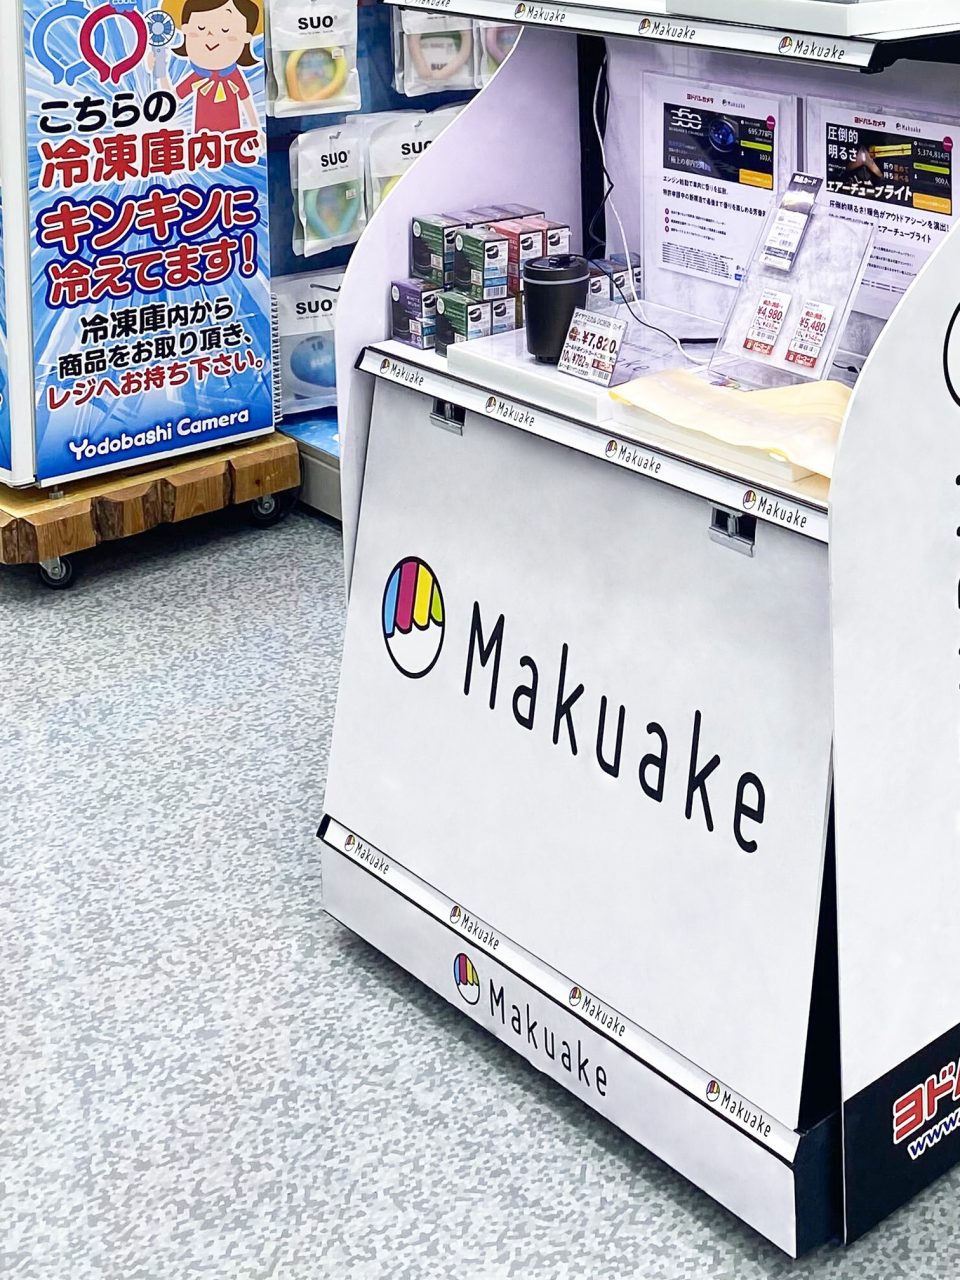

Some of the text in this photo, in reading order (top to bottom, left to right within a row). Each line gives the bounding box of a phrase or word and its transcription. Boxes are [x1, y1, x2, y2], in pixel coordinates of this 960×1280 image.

[297, 16, 334, 30] SUO
[526, 5, 566, 23] Makuake
[651, 21, 696, 40] Makuake
[794, 39, 845, 61] Makuake
[39, 91, 178, 135] こちらの
[854, 116, 886, 128] ヨドバシカメラ
[827, 126, 859, 144] 圧倒的
[40, 129, 259, 189] 冷凍庫内で
[320, 150, 348, 168] SUO
[828, 144, 857, 162] 明るさ
[826, 181, 913, 201] エアーチューブライト
[43, 189, 256, 254] キンキンに
[49, 234, 258, 304] 冷えてます!
[80, 296, 234, 346] 冷凍庫内から
[295, 299, 333, 315] SUO
[757, 305, 783, 321] ¥4,980
[799, 317, 826, 333] ¥5,480
[58, 322, 252, 379] 商品をお取り頂き、
[48, 350, 264, 410] レジへお持ち下さい。
[389, 360, 425, 387] Makuake
[496, 401, 535, 427] Makuake
[69, 409, 250, 461] Yodobashi Camera
[618, 443, 661, 474] Makuake
[757, 495, 808, 529] Makuake
[464, 600, 767, 854] Makuake
[354, 841, 390, 875] Makuake
[461, 912, 500, 951] Makuake
[581, 995, 627, 1038] Makuake
[489, 978, 609, 1097] Makuake
[721, 1090, 772, 1138] Makuake
